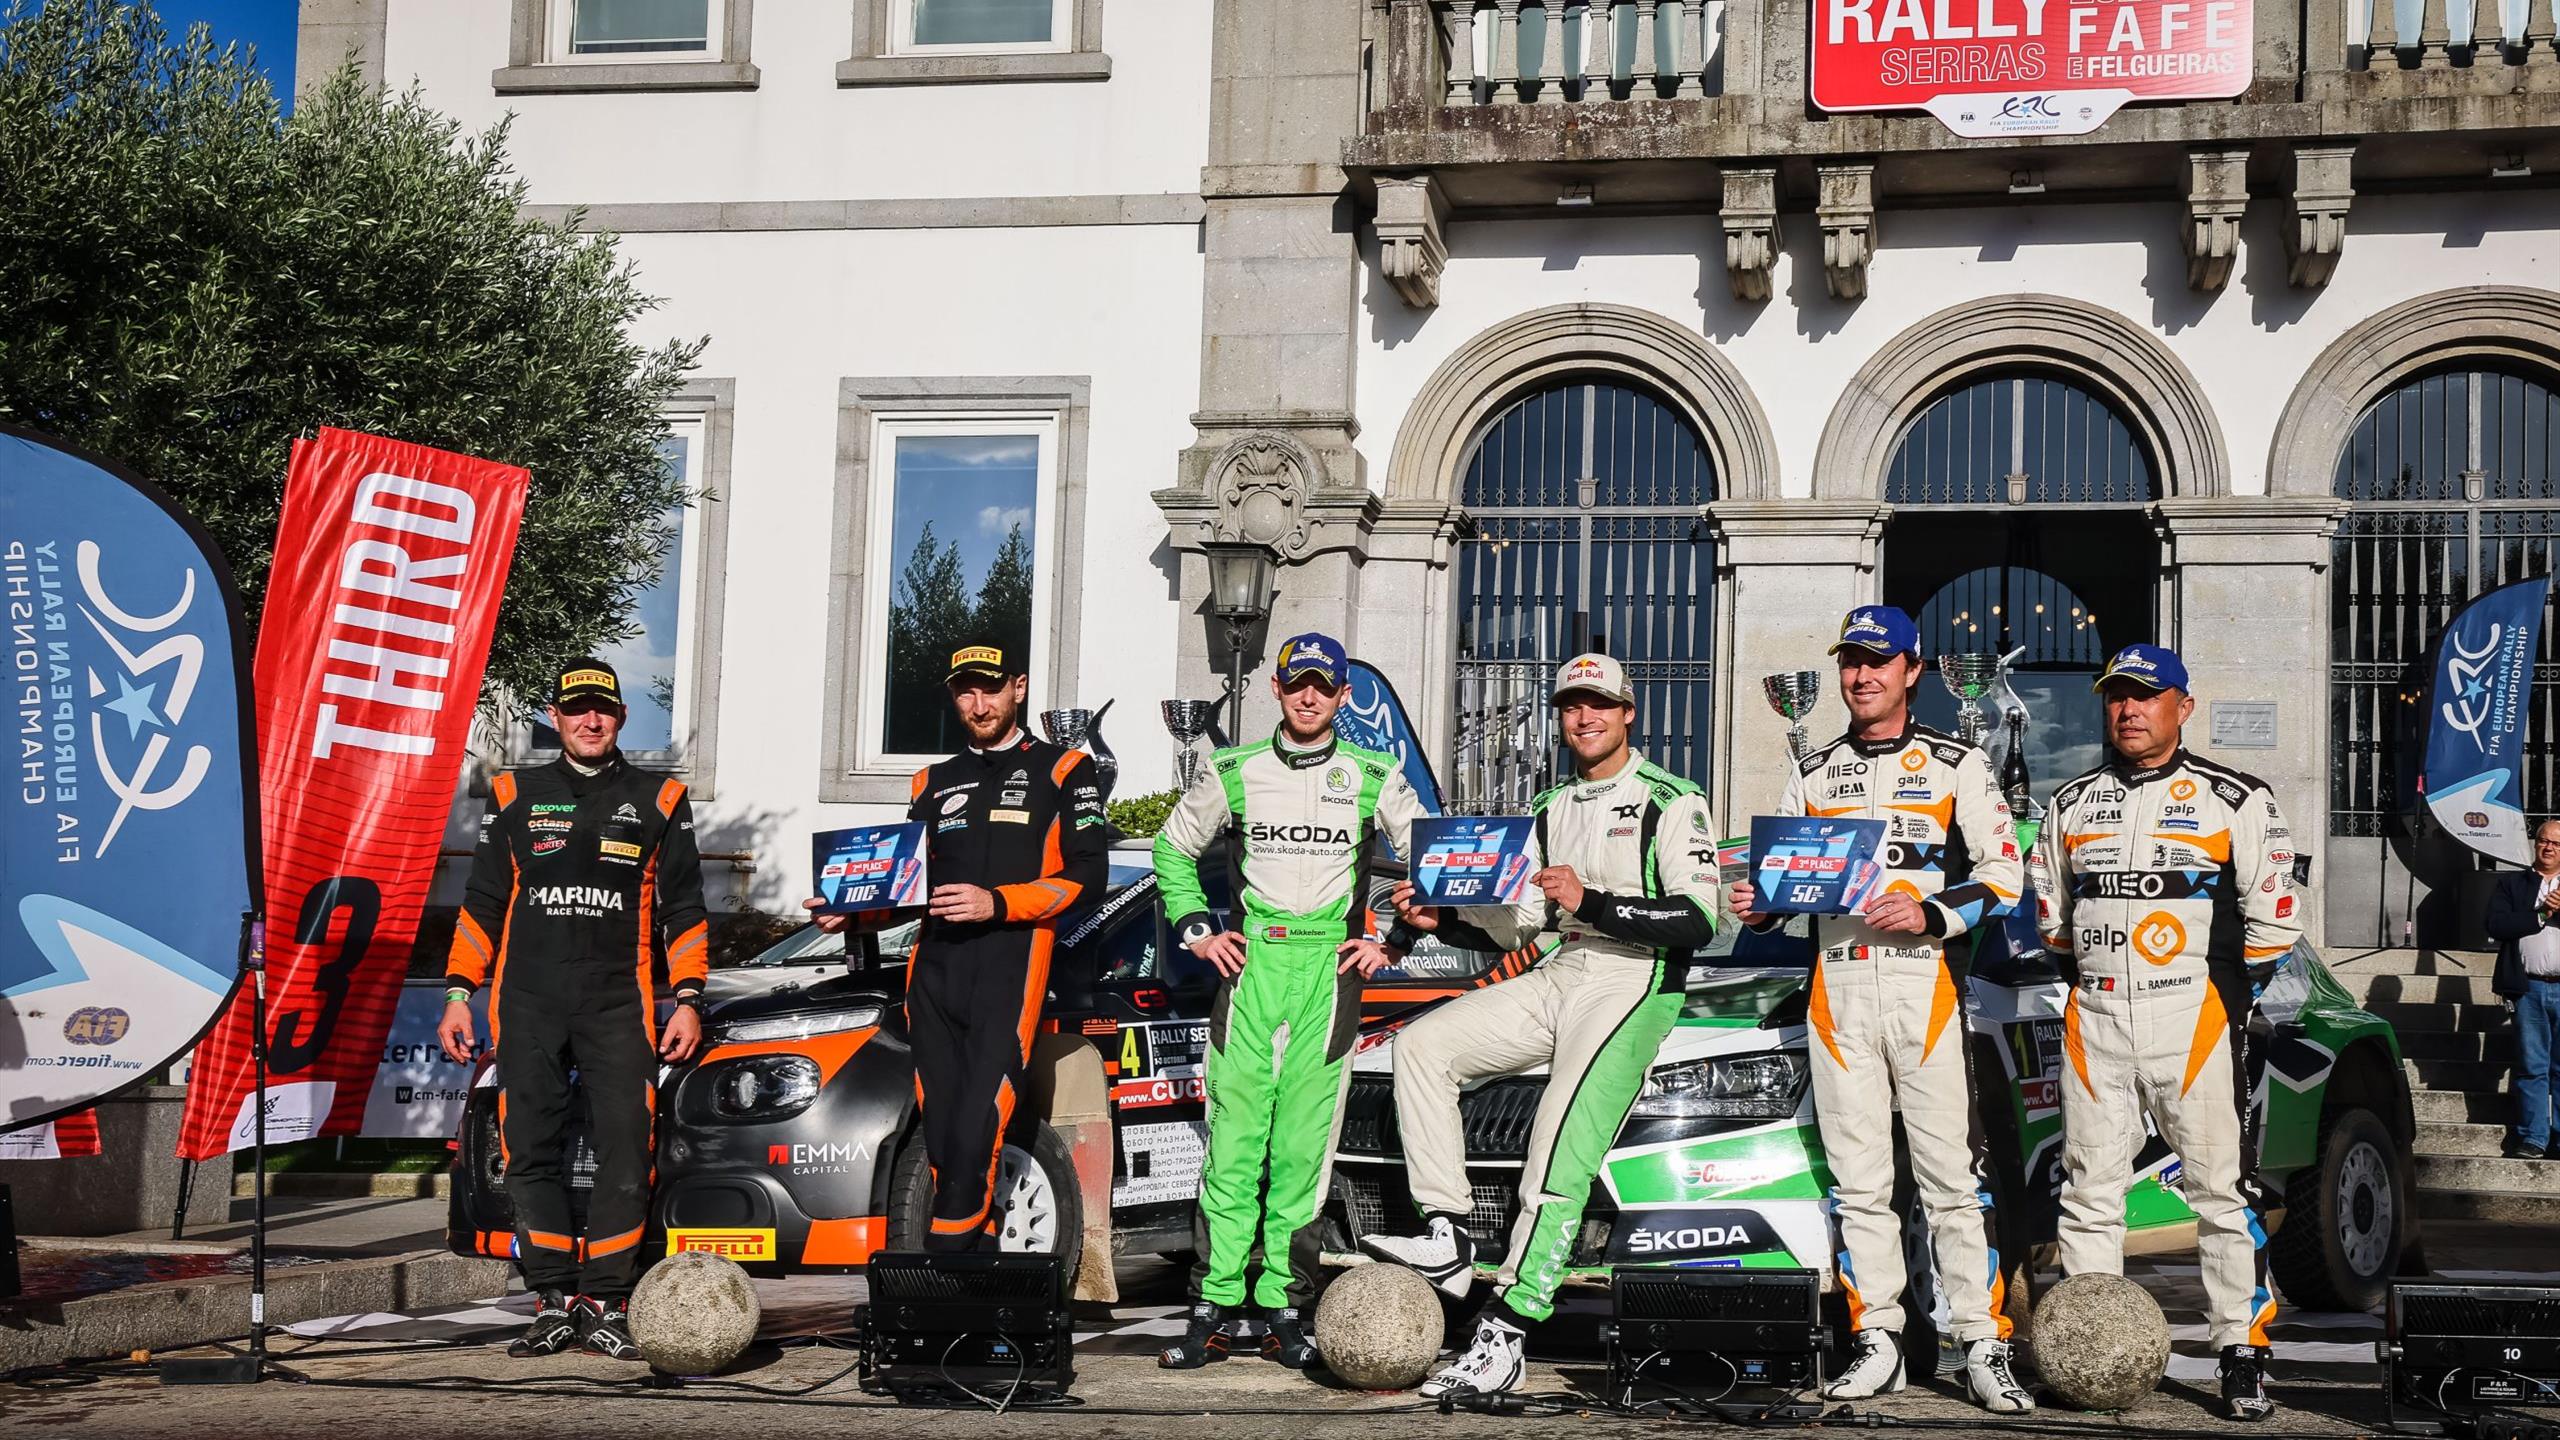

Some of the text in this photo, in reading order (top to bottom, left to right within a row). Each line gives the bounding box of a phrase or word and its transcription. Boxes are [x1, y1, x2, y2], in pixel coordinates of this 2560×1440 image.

[1829, 0, 2048, 44] RALLY
[2068, 2, 2236, 53] FAFE
[1881, 43, 2047, 86] SERRAS
[2067, 53, 2235, 80] E FELGUEIRAS
[1960, 113, 1976, 122] FIA
[311, 472, 476, 759] THIRD
[954, 648, 998, 664] PIRELLI
[564, 671, 613, 687] PIRELLI
[1566, 670, 1604, 683] Red Bull
[2504, 626, 2529, 733] CHAMPIONSHIP
[2489, 625, 2517, 756] FIA EUROPEAN RALLY
[1937, 749, 1960, 760] OMP
[1218, 760, 1237, 773] OMP
[1804, 756, 1824, 770] OMP
[1366, 765, 1386, 778] OMP
[1898, 775, 1928, 788] galp
[1654, 786, 1673, 801] OMP
[2217, 784, 2241, 800] OMP
[1321, 795, 1354, 805] ŠKODA
[531, 803, 577, 812] ekover
[2165, 804, 2195, 816] galp
[528, 818, 573, 829] octane
[1251, 823, 1352, 845] ŠKODA
[533, 839, 567, 852] HORTEX
[1465, 855, 1487, 864] PLACE
[2031, 855, 2048, 866] ELL
[2271, 852, 2294, 860] BELL
[863, 861, 883, 872] PLACE
[1798, 859, 1834, 869] 3rd PLACE
[529, 885, 623, 911] MARINA
[546, 906, 603, 917] RACE WEAR
[1289, 928, 1327, 937] Mikkelsen
[2082, 924, 2127, 953] galp
[1827, 950, 1843, 960] OMP
[1884, 948, 1931, 959] A. ARAUJO
[1401, 952, 1458, 970] Arnautov
[268, 877, 381, 1075] 3
[2138, 976, 2192, 991] L. RAMALHO
[1151, 1027, 1188, 1045] RALLY
[1121, 1027, 1141, 1077] 4
[2014, 1023, 2030, 1077] 1
[793, 1141, 870, 1164] EMMA
[793, 1165, 849, 1176] CAPITAL
[676, 1234, 764, 1257] PIRELLI
[1629, 1225, 1751, 1252] ŠKODA
[2503, 1348, 2521, 1360] 10
